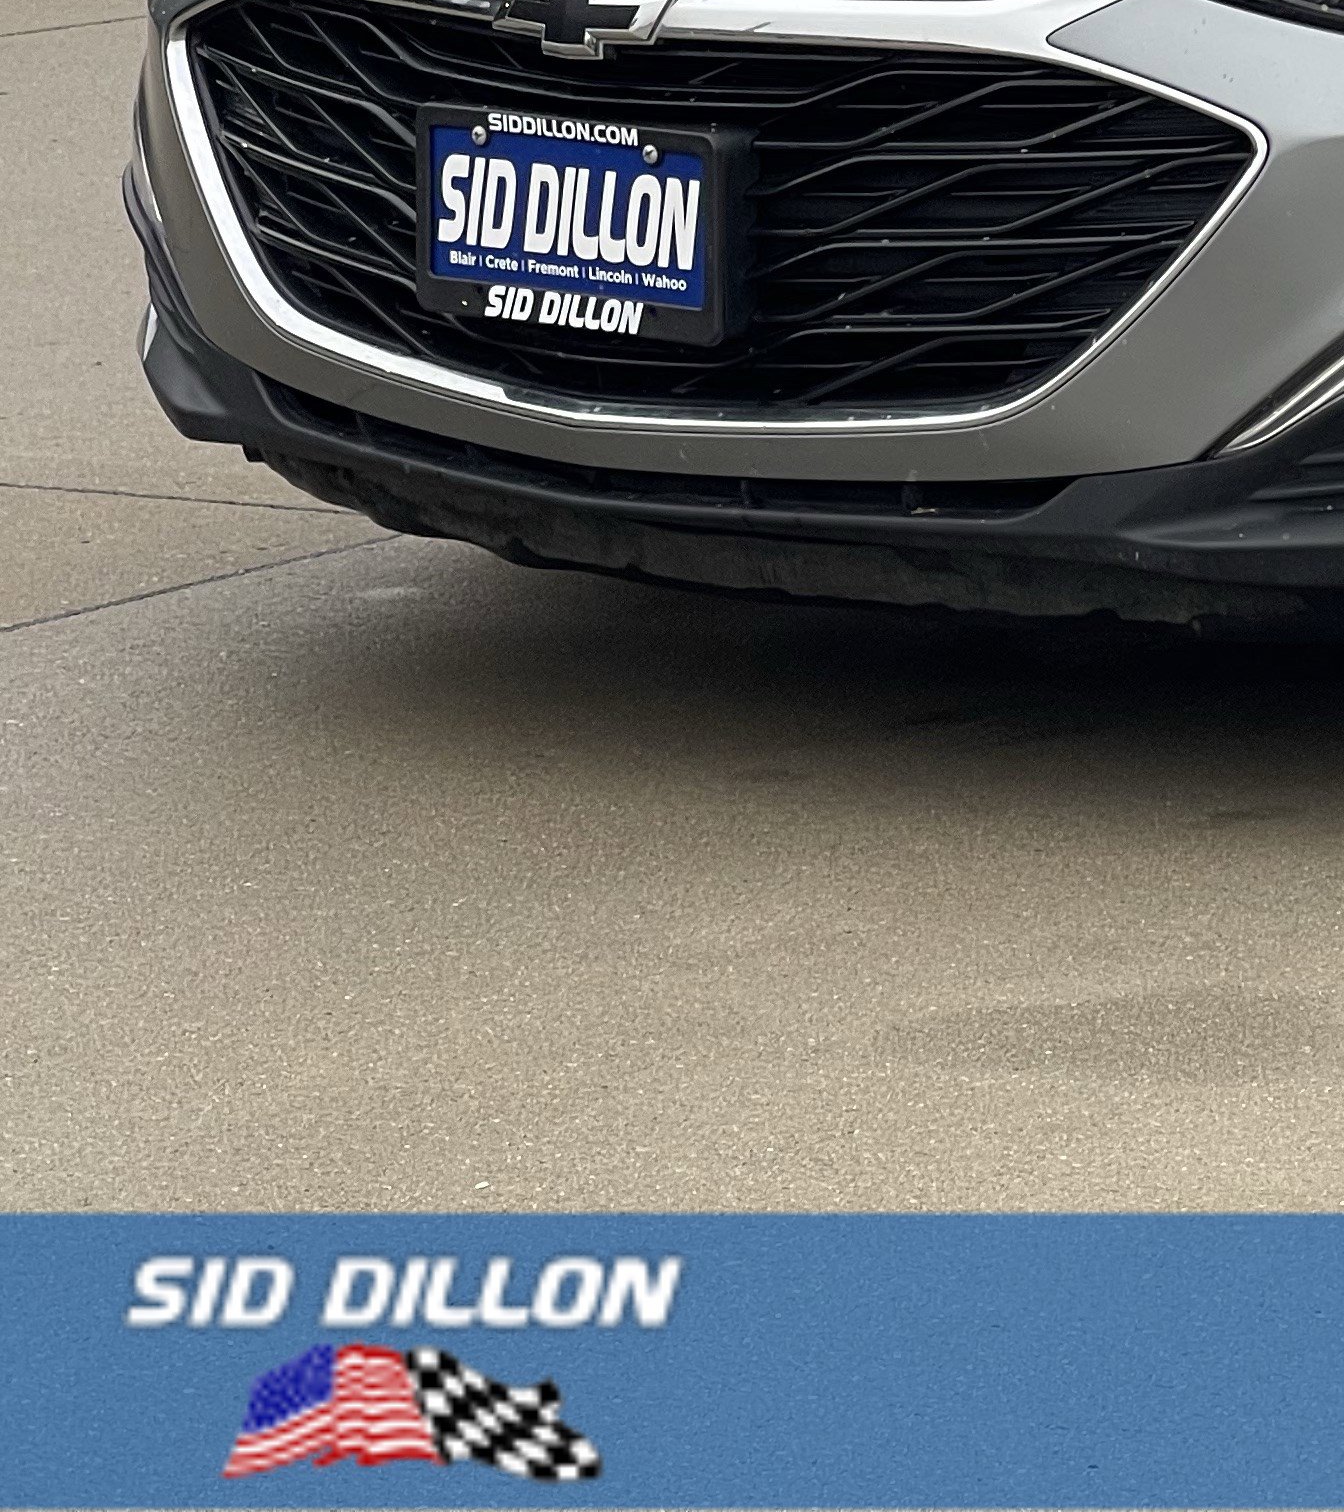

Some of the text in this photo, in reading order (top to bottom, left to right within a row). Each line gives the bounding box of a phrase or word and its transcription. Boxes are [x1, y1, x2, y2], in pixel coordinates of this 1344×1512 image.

[488, 112, 639, 147] SIDDILLON.COM
[438, 154, 700, 271] SID DILLON
[449, 250, 687, 291] Blair Crete Fremont Lincoln Wahoo
[484, 285, 644, 335] SID DILLON
